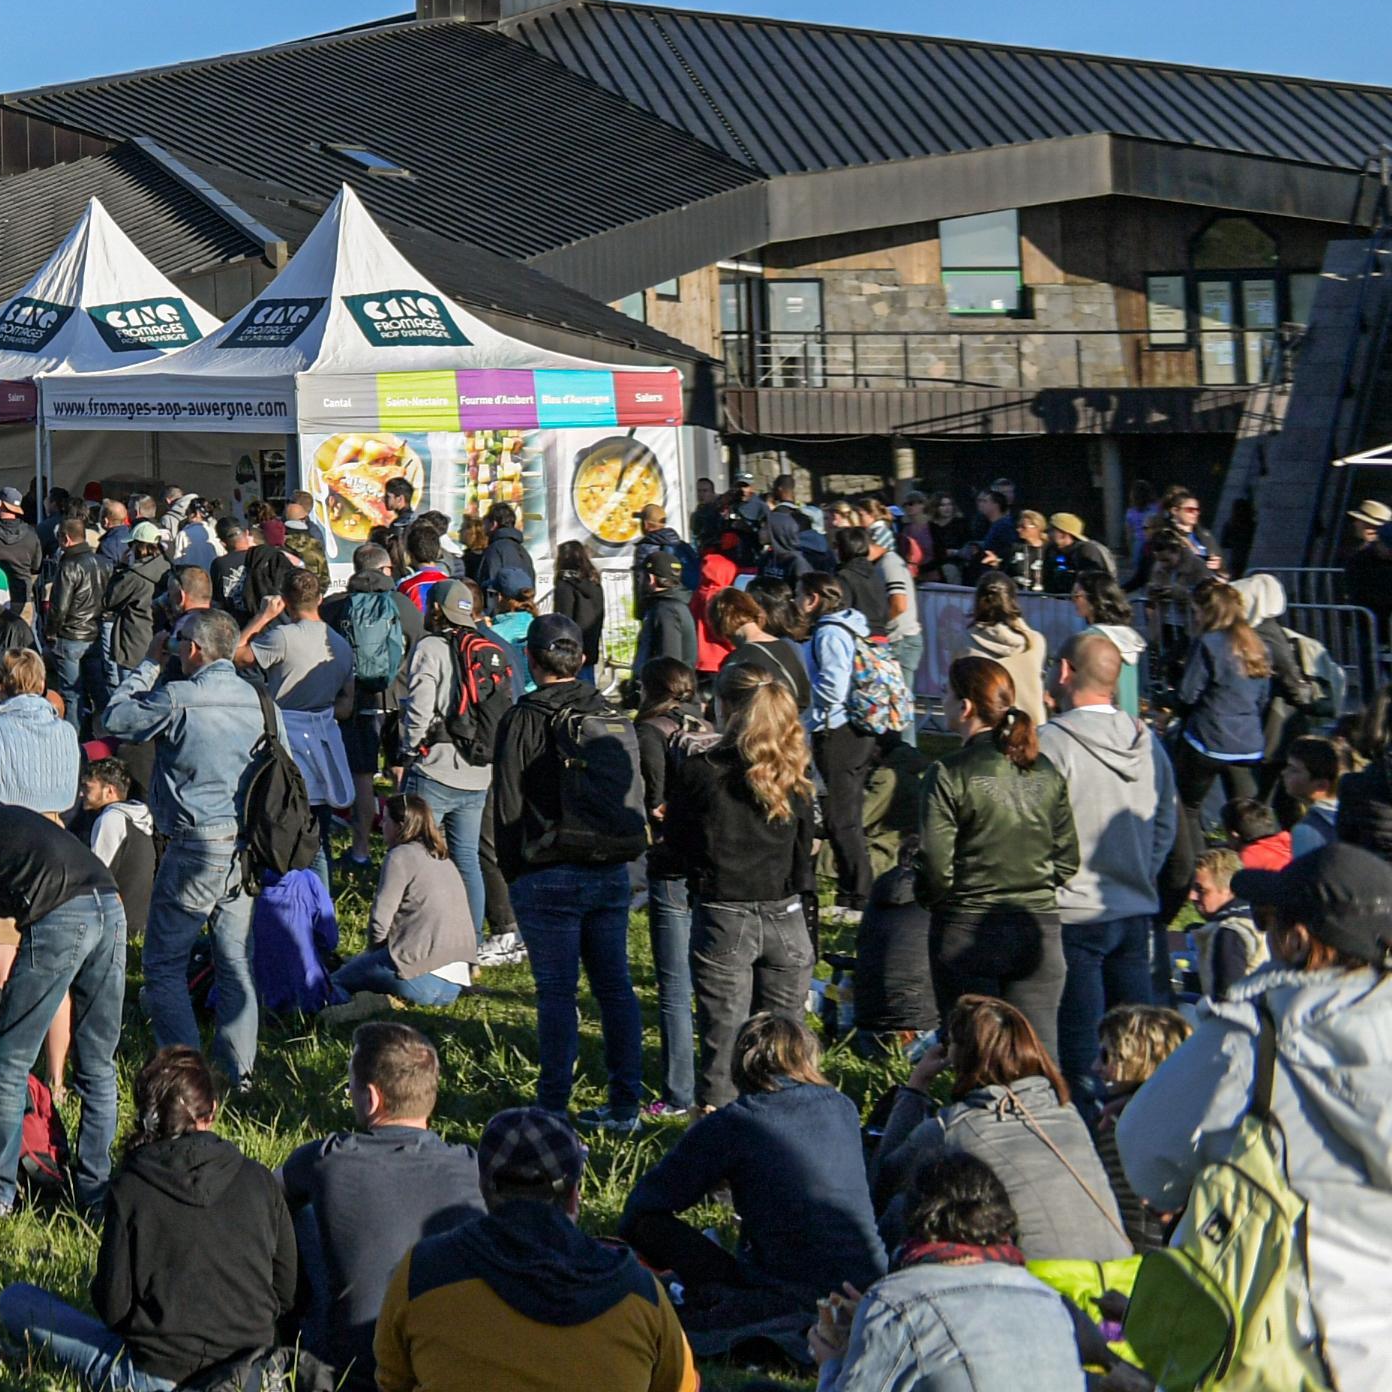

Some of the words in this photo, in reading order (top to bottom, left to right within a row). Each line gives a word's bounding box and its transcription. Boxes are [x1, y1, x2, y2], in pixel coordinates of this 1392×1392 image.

[115, 322, 186, 339] FROMAGES
[374, 318, 446, 331] FROMAGES
[402, 329, 450, 339] D'AUVERGNE
[7, 393, 25, 403] Salers
[323, 398, 352, 409] Cantal
[386, 396, 449, 407] Saint-Nectaire
[460, 395, 493, 406] Fourme
[494, 394, 534, 405] d'Ambert
[635, 392, 664, 404] Salers
[53, 397, 288, 420] www.fromages-aop-auvergne.com
